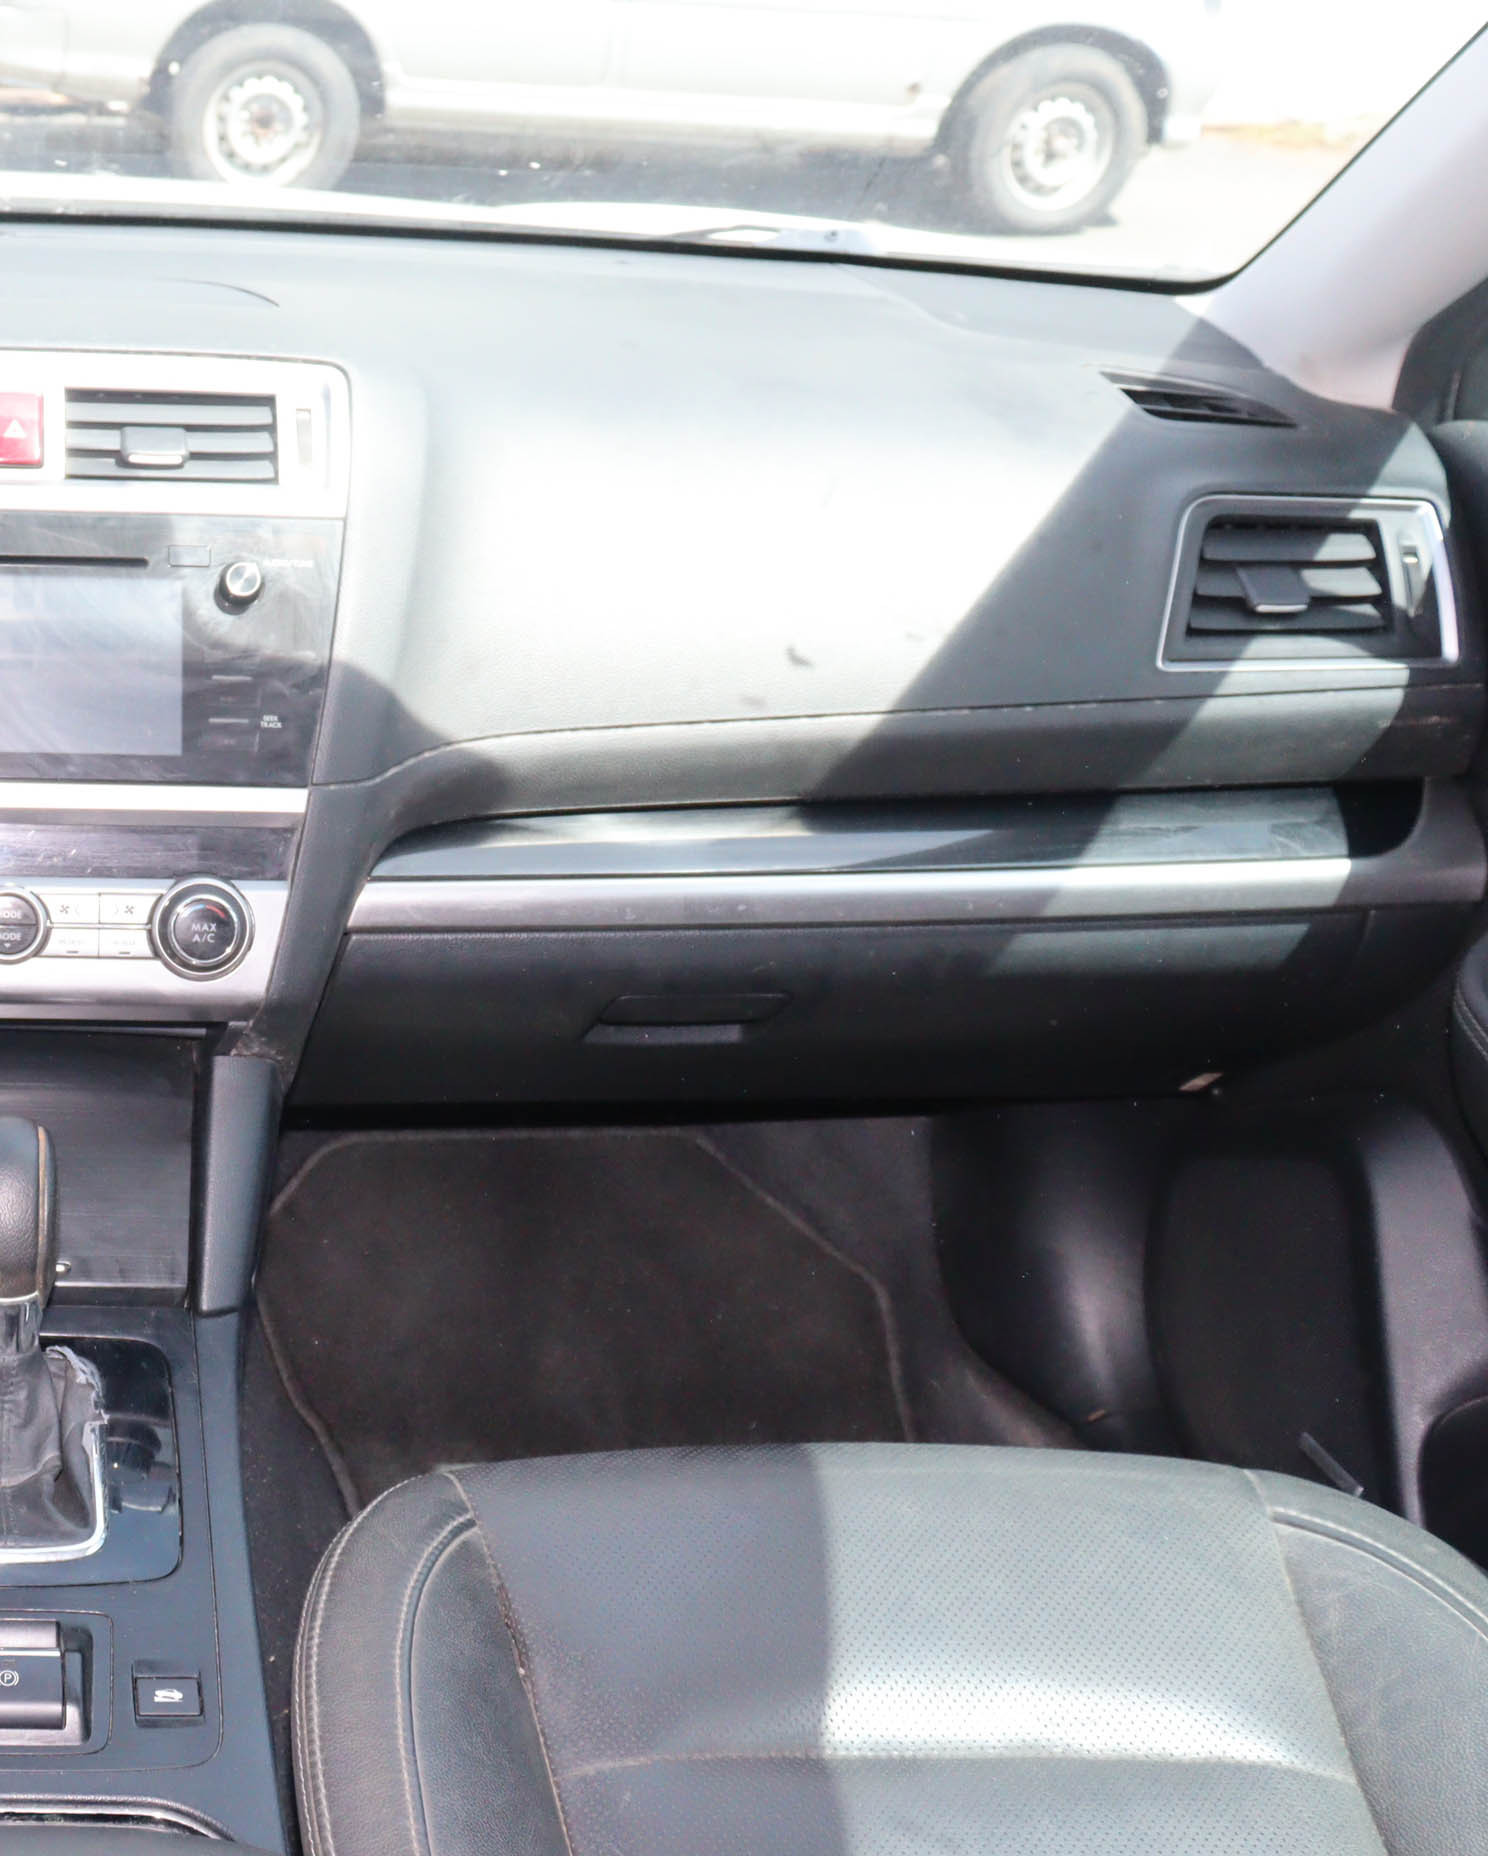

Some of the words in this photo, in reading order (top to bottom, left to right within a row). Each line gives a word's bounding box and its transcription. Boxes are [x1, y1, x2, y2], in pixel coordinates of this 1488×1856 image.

[260, 721, 282, 729] TRACK
[192, 922, 217, 932] MAX
[192, 933, 216, 943] A/C
